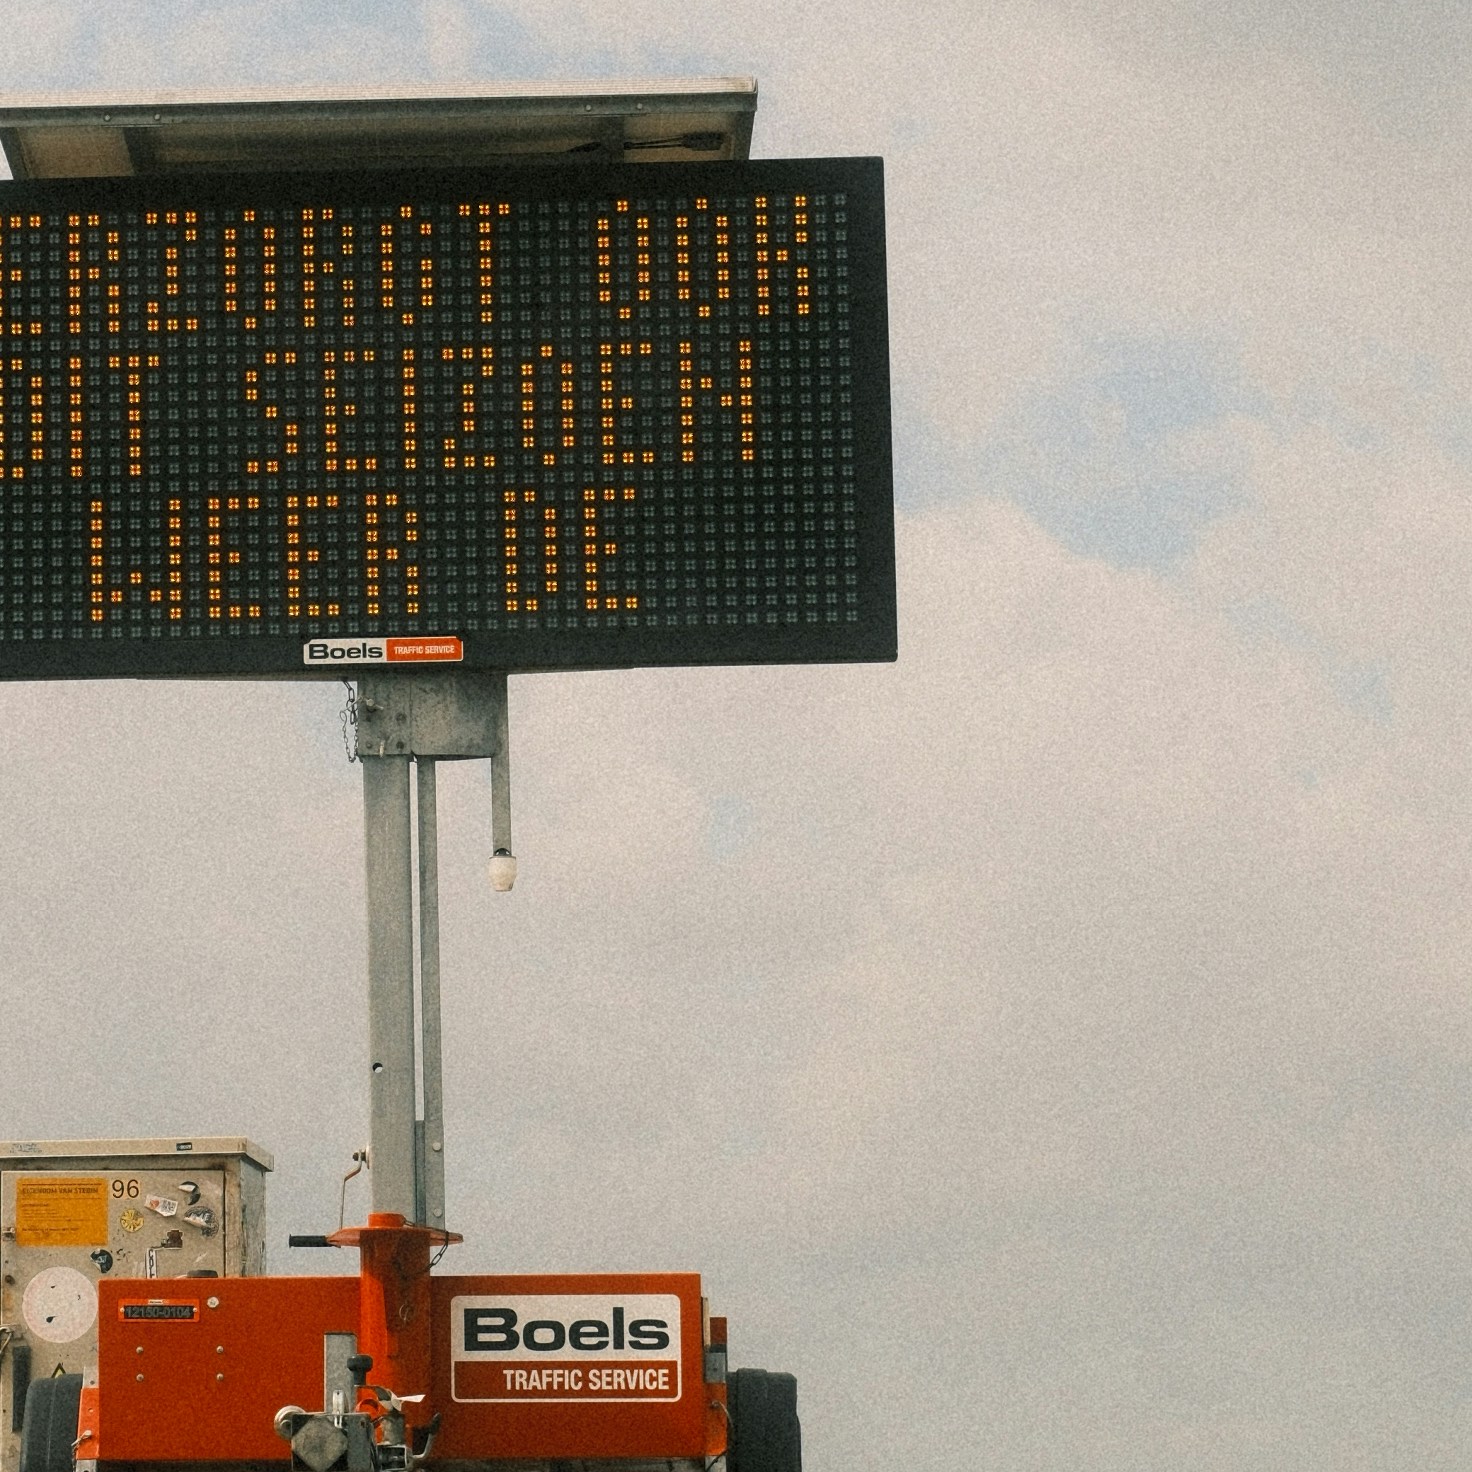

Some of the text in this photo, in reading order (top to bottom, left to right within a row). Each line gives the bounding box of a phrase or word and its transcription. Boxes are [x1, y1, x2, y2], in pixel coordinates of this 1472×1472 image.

[596, 195, 810, 321] OOK
[245, 339, 754, 473] SEIZOEN
[90, 487, 639, 622] WEER DE
[308, 642, 455, 660] Boels TRAFFIC SERVICE
[111, 1179, 140, 1199] 96
[463, 1306, 670, 1352] Boels
[502, 1369, 670, 1390] TRAFFIC SERVICE
